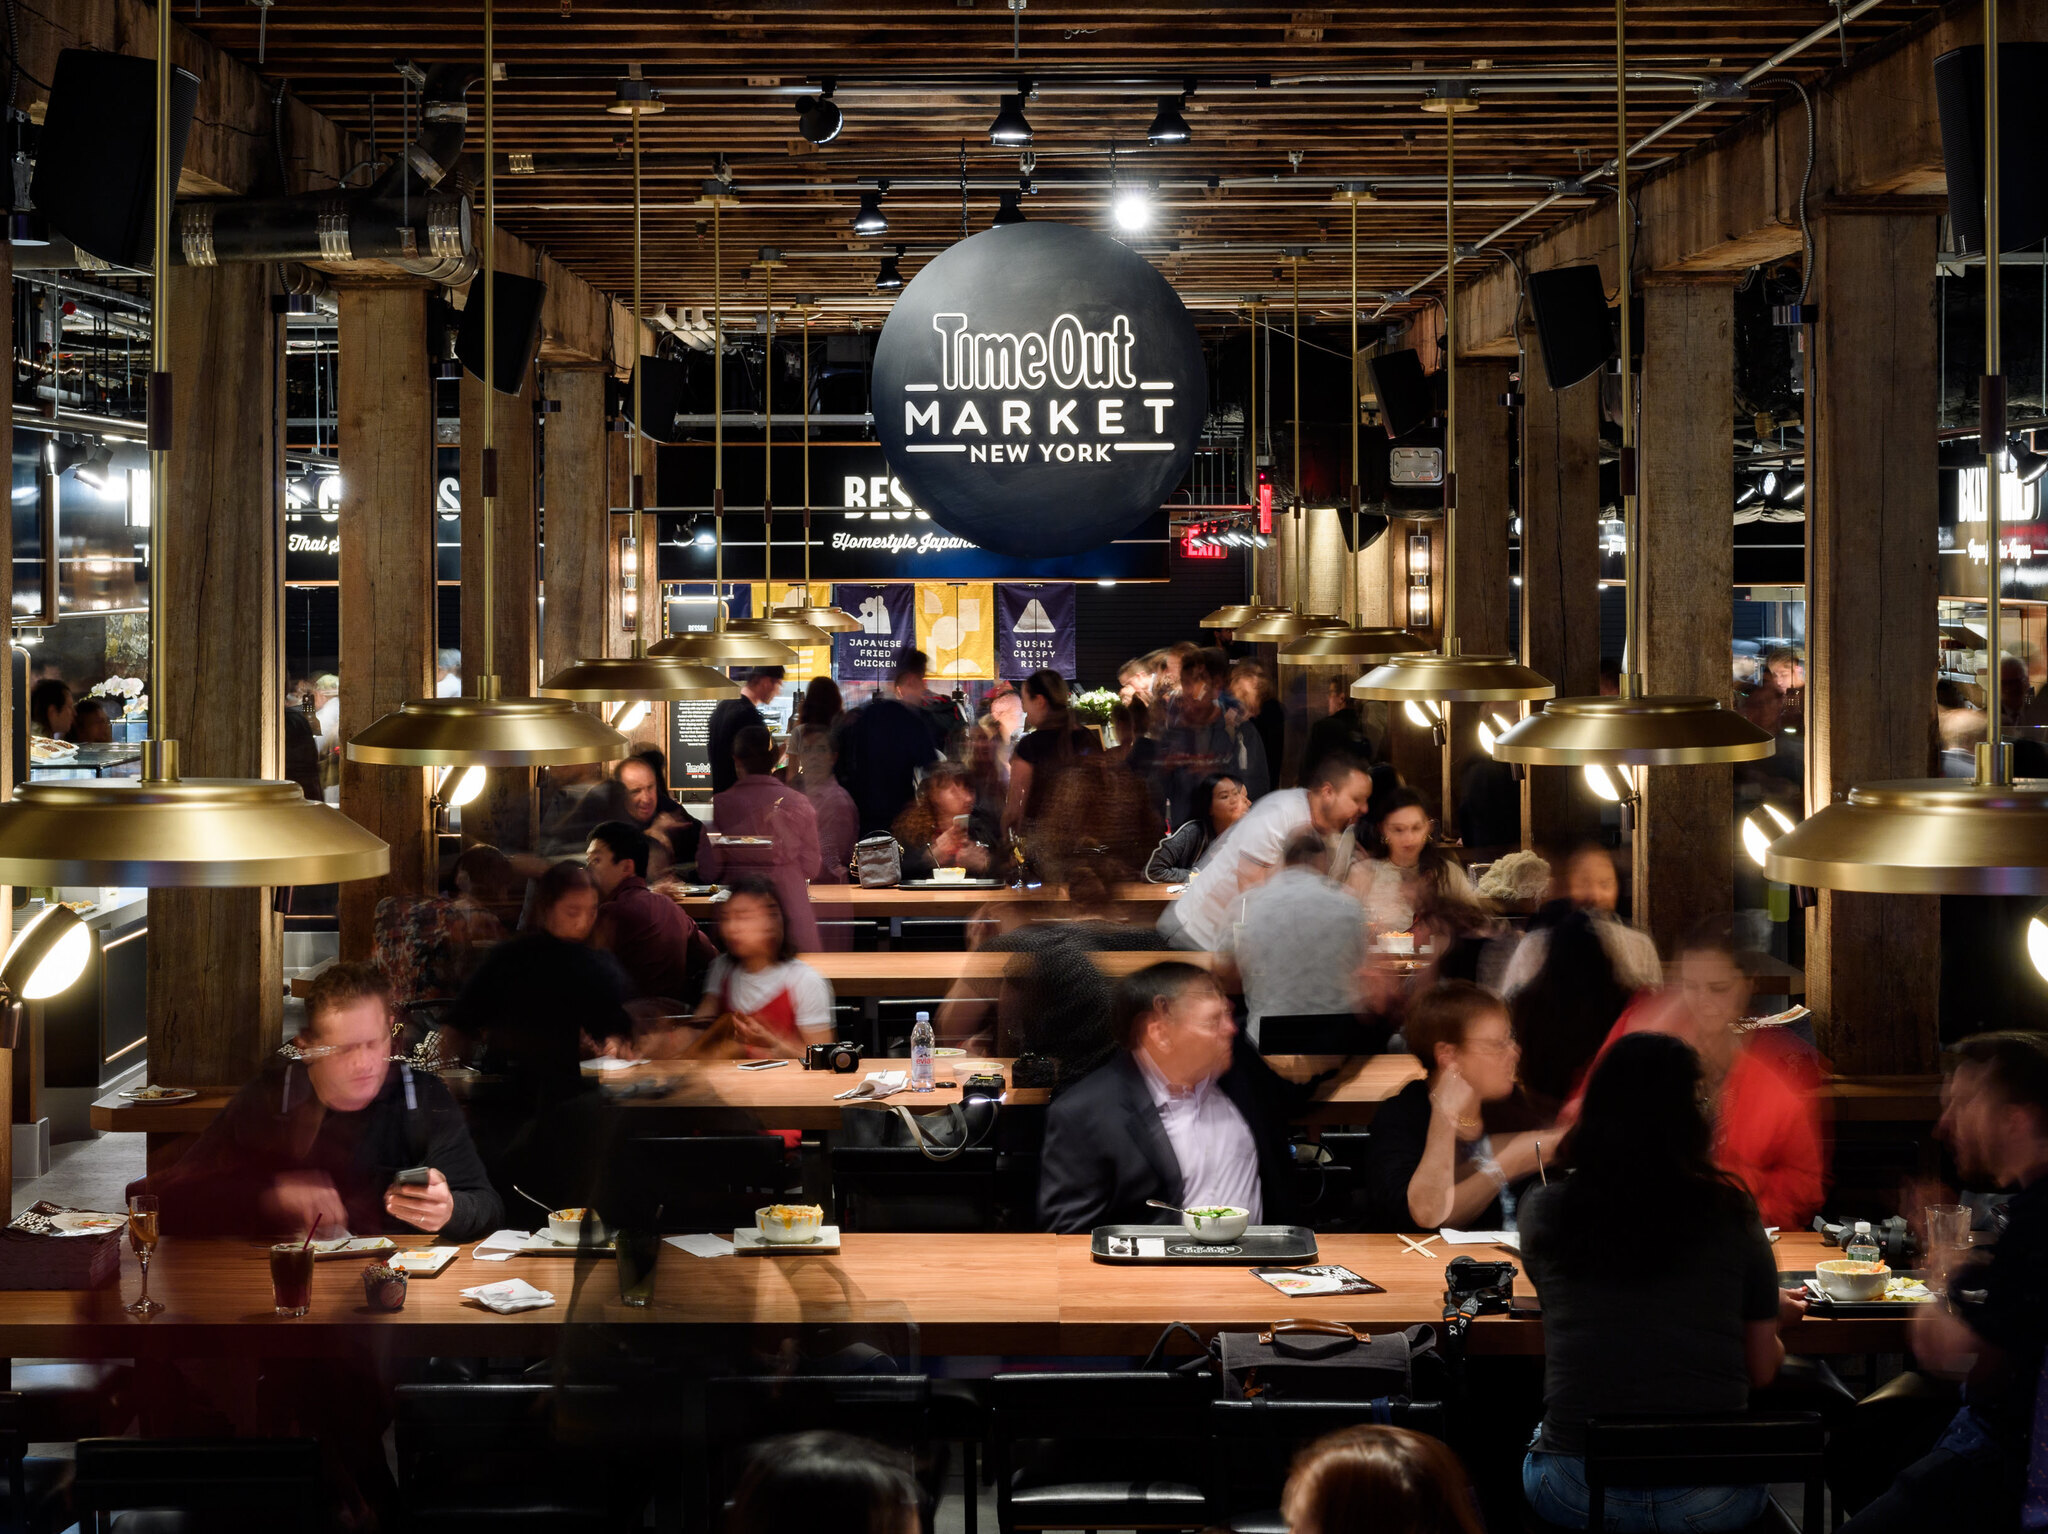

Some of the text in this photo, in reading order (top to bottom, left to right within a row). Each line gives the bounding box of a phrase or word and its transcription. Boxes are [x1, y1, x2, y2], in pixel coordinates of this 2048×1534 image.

[933, 313, 1137, 390] Time Out
[905, 399, 1174, 436] MARKET
[970, 443, 1112, 463] NEW YORK
[844, 476, 931, 520] BES
[288, 534, 328, 552] Thai
[832, 532, 981, 554] Homestyle Japan
[849, 638, 902, 648] JAPANESE
[1015, 640, 1053, 648] SUSHI
[860, 649, 891, 658] FRIED
[1013, 650, 1056, 659] CRISPY
[854, 659, 897, 668] CHICKEN
[1021, 660, 1049, 668] RICE
